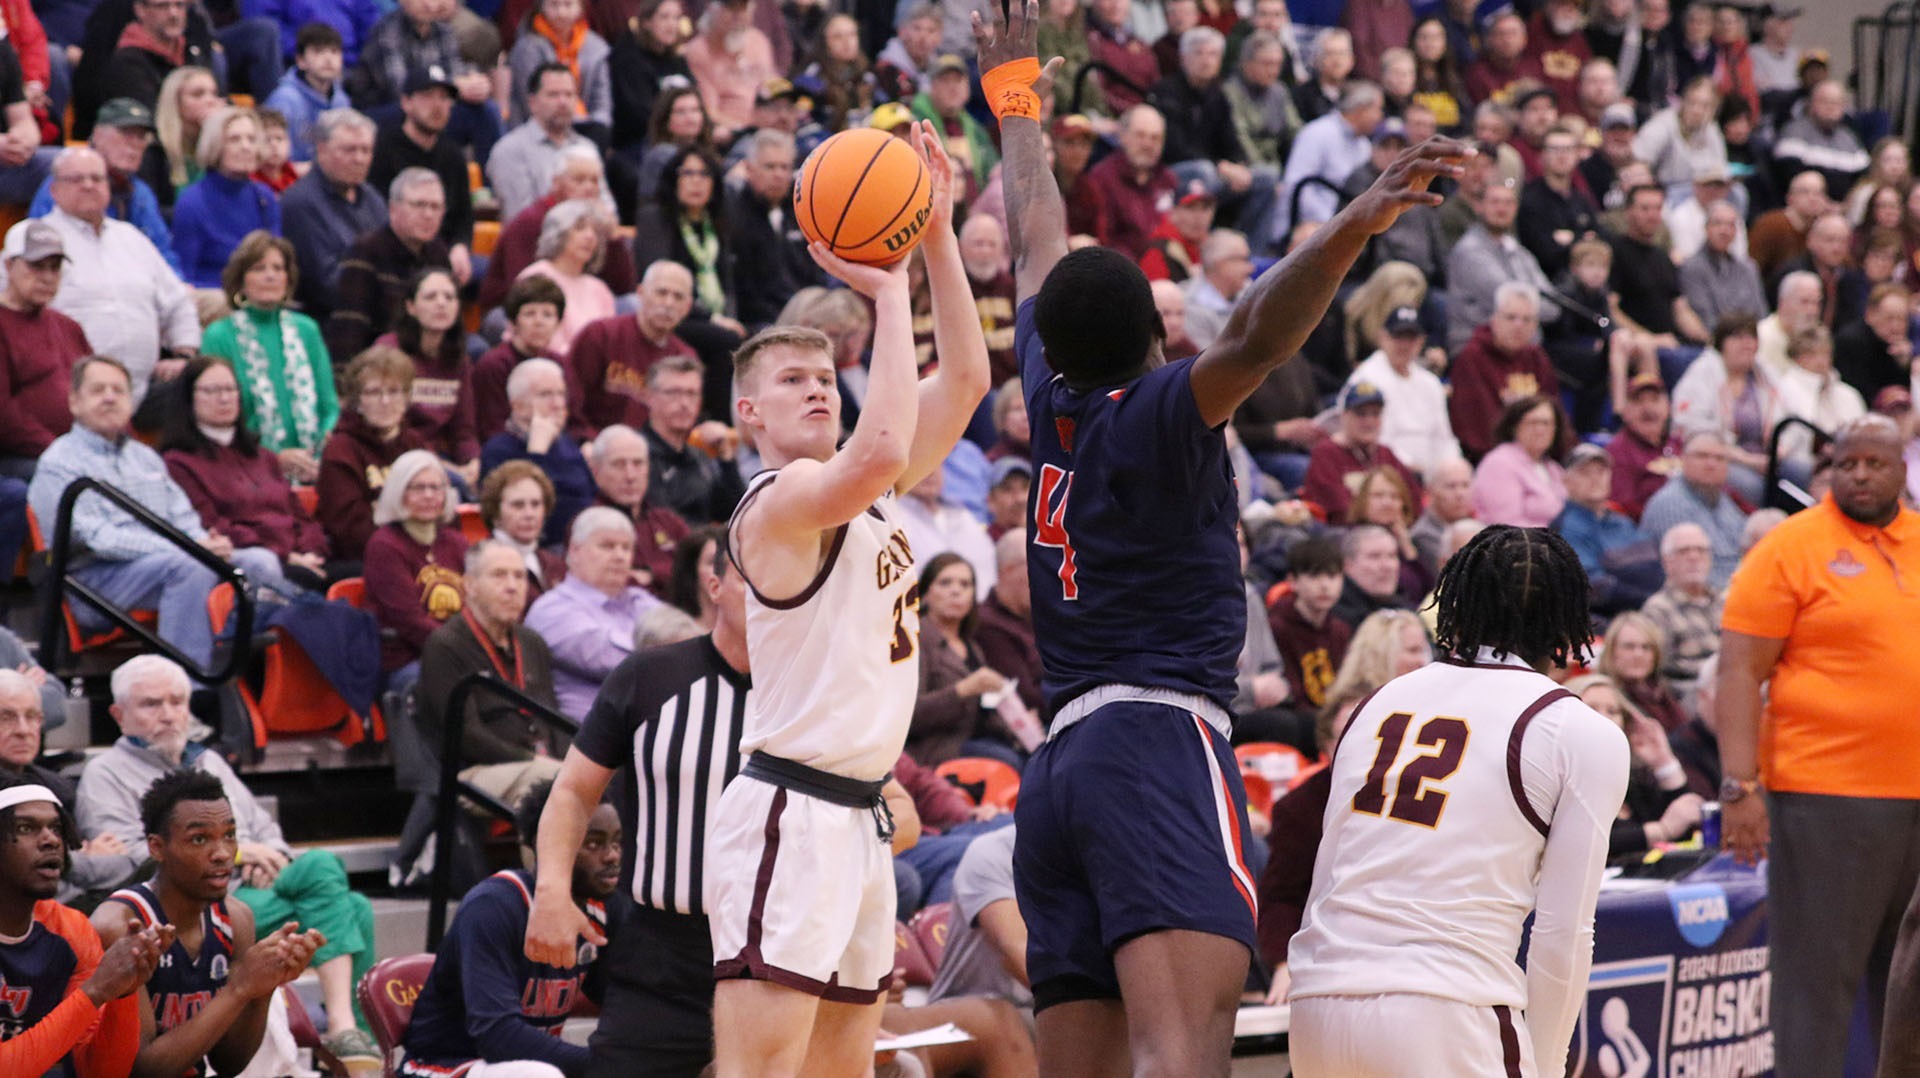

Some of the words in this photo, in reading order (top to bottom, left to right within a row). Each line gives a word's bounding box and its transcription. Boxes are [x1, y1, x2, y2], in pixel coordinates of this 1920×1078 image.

[1033, 463, 1078, 600] 4
[1352, 711, 1472, 831] 12
[1678, 954, 1719, 983] 2024
